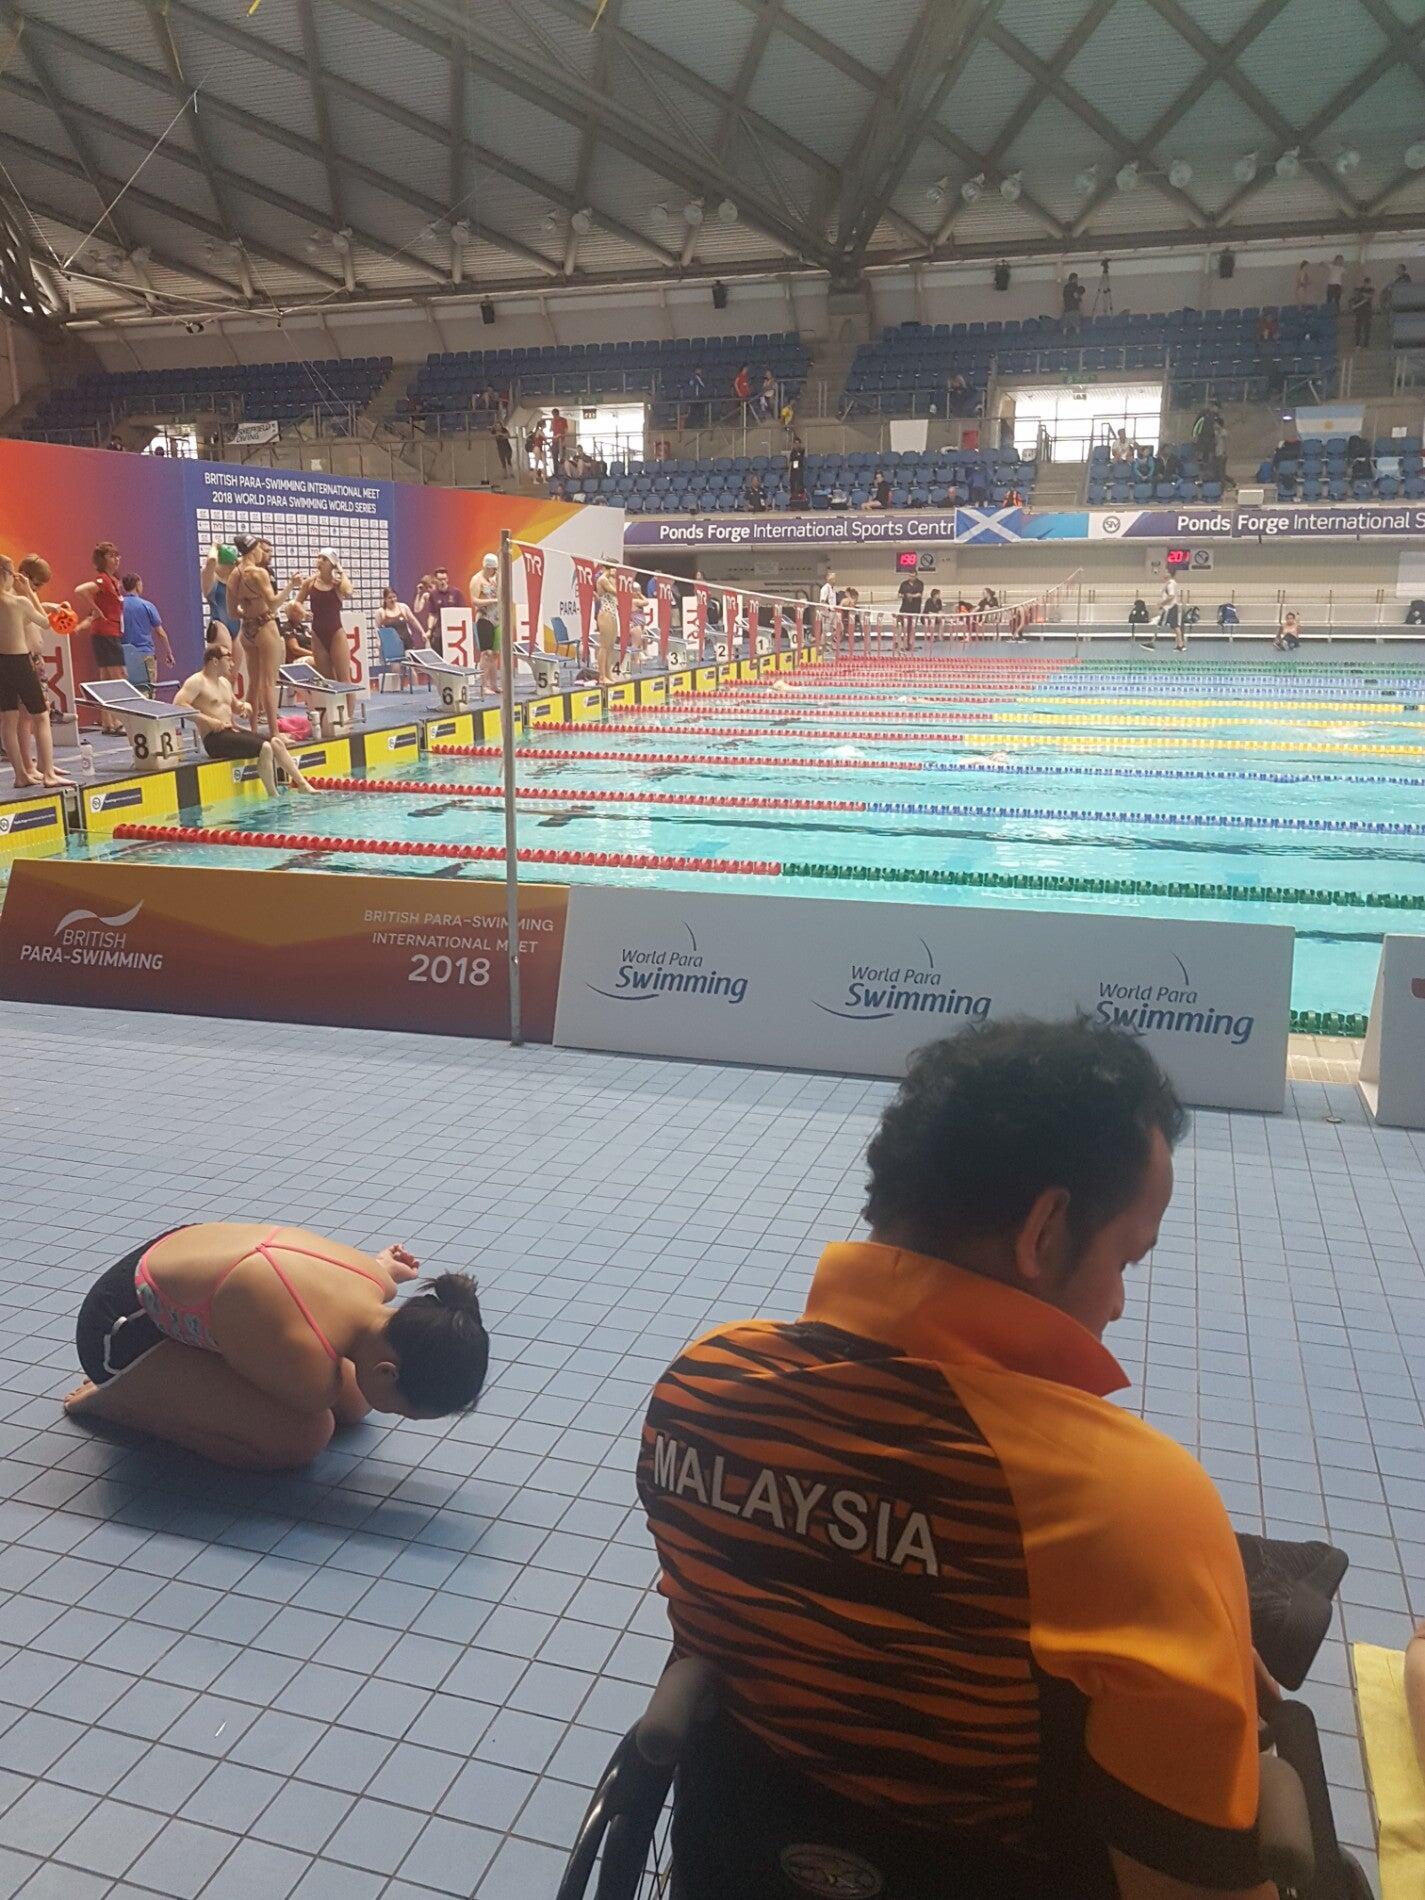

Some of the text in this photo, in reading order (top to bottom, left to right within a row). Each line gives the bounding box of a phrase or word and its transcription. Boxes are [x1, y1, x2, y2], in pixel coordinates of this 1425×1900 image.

[204, 472, 380, 499] BRITISH PARA-SWIMMING INTERNATIONAL MEET
[212, 491, 377, 514] 2018 WORLD PARA SWIMMING WORLD SERIES
[660, 519, 954, 542] Ponds Forge International Sports Centr
[1177, 515, 1231, 532] Ponds
[1238, 514, 1290, 534] Forge
[1293, 512, 1410, 530] International
[524, 552, 542, 576] TYR
[577, 565, 593, 586] TYR
[619, 575, 633, 593] TYR
[670, 652, 679, 666] 3
[718, 645, 726, 657] 2
[612, 661, 621, 676] 4
[538, 672, 548, 689] 5
[442, 687, 453, 706] 6
[134, 733, 149, 759] 8
[364, 910, 420, 925] BRITISH
[62, 929, 127, 949] BRITISH
[372, 932, 538, 953] INTERNATIONAL MET
[20, 944, 163, 970] PARA-SWIMMING
[622, 949, 704, 968] World Para
[408, 953, 491, 986] 2018
[851, 965, 941, 986] World Para
[615, 965, 749, 1004] Swimming
[1099, 982, 1198, 1004] World Para
[845, 982, 992, 1021] Swimming
[1096, 1000, 1254, 1045] Swimming
[654, 1433, 939, 1577] MALAYSIA
